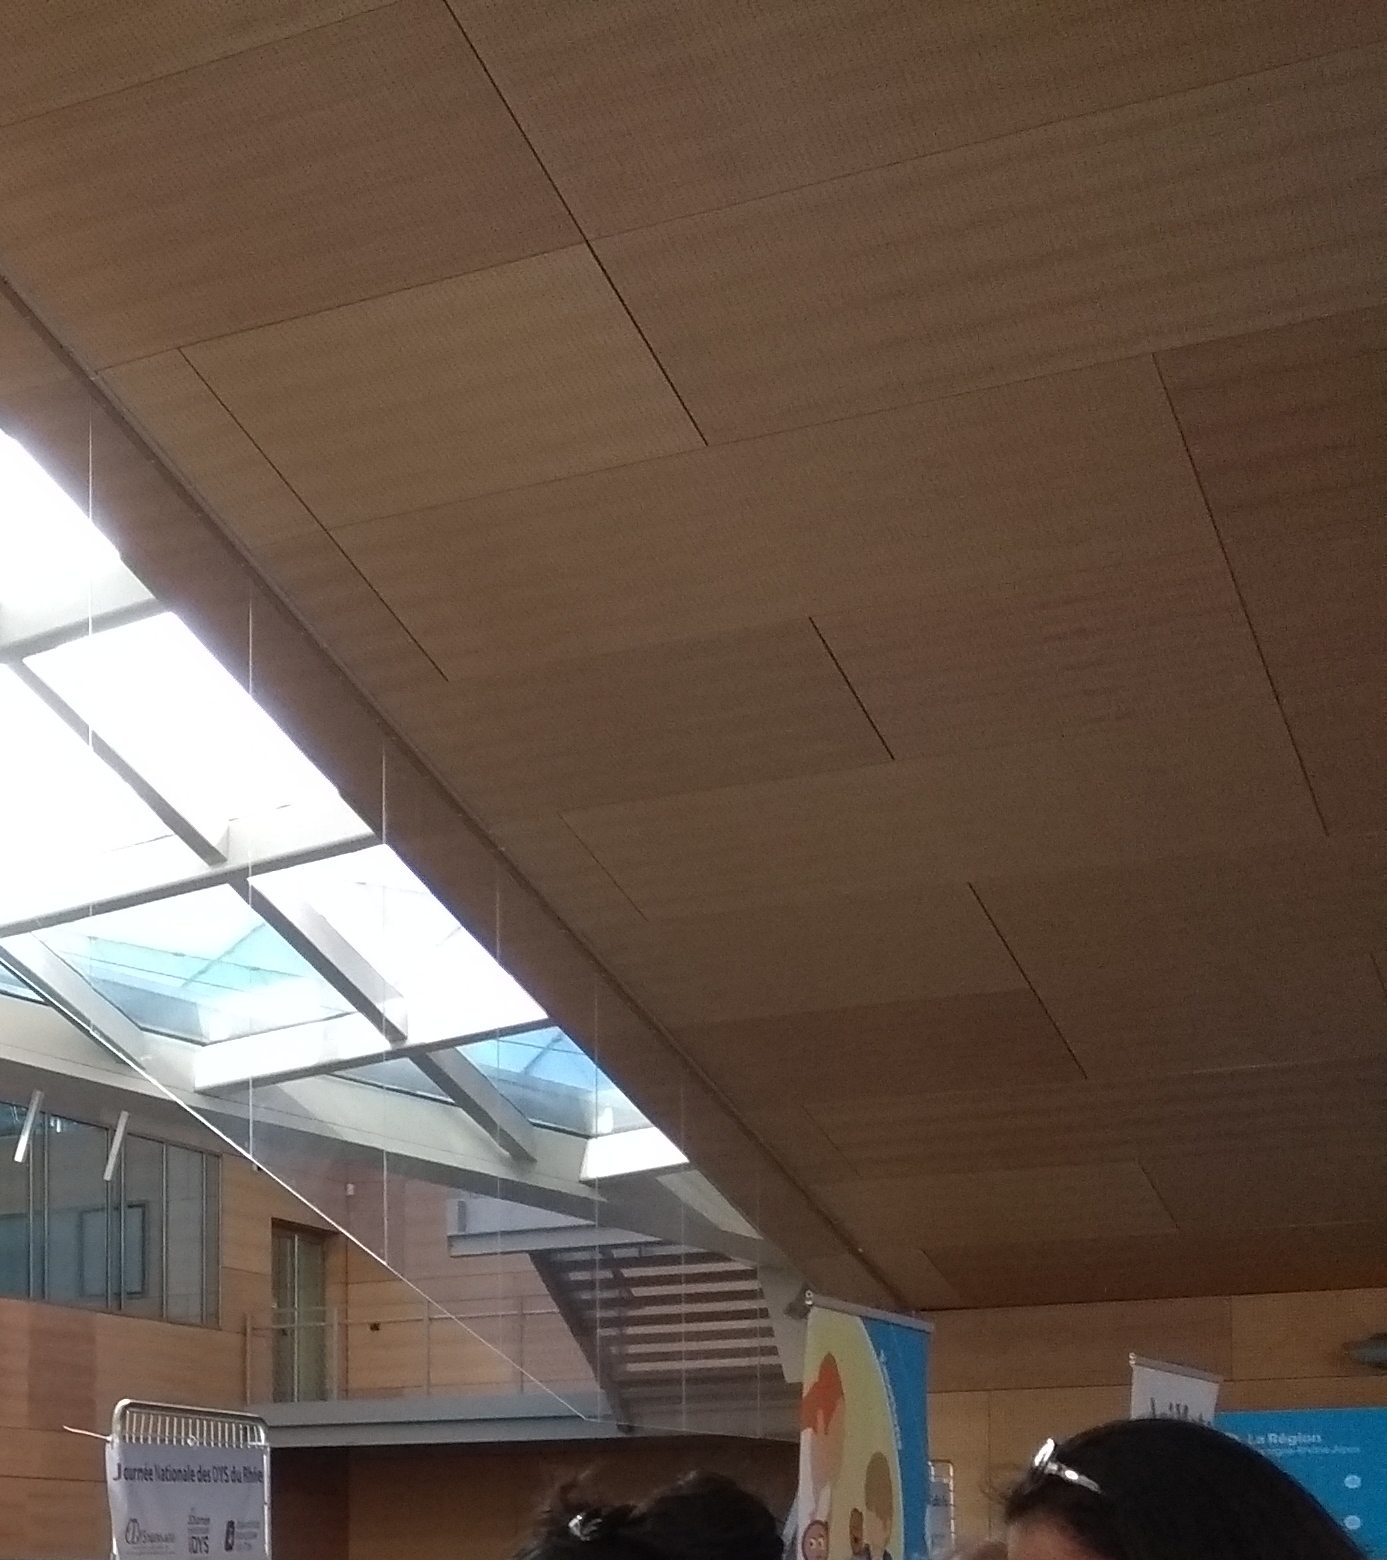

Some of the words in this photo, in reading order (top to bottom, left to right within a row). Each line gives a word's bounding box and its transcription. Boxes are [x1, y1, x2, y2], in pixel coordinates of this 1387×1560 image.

[1267, 1432, 1322, 1446] Région
[113, 1463, 153, 1481] Journée
[154, 1464, 195, 1482] Nationale
[197, 1464, 211, 1482] des
[212, 1465, 228, 1482] DYS
[230, 1465, 242, 1482] du
